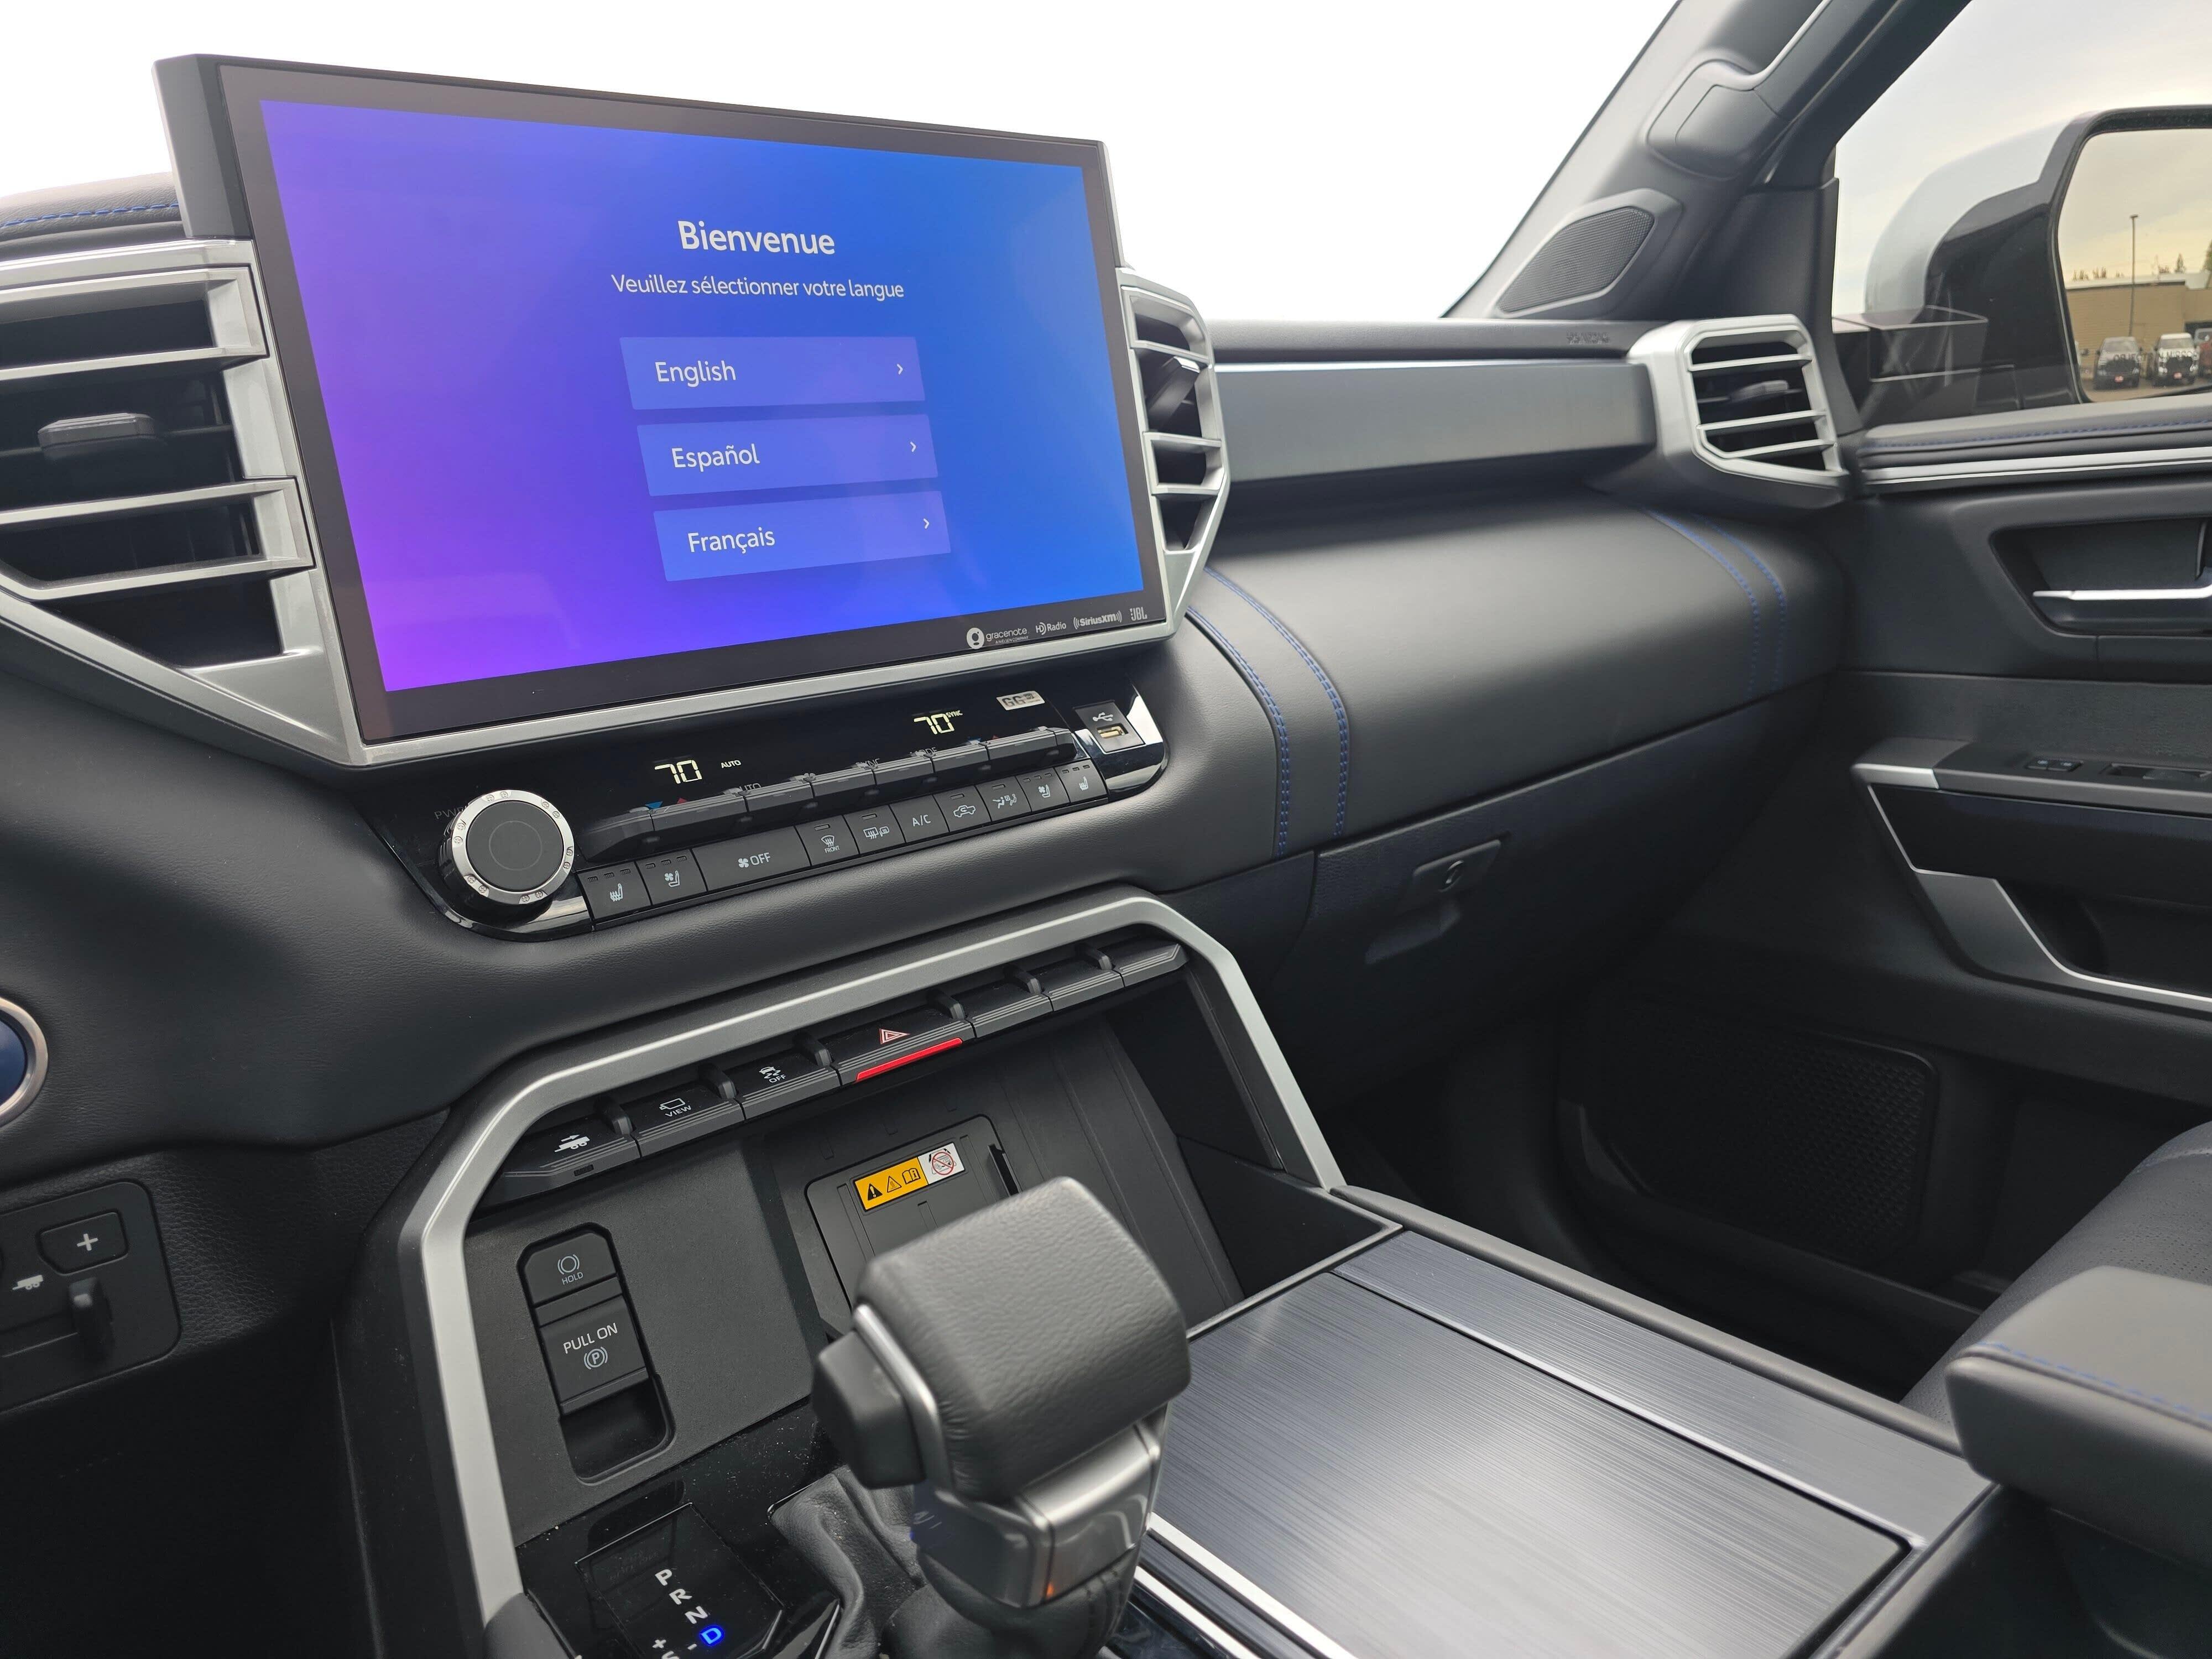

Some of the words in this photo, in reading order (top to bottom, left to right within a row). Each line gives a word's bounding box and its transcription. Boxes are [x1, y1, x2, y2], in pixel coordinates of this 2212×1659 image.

[678, 220, 836, 255] Bienvenue
[611, 274, 688, 294] Veuillez
[691, 275, 799, 296] sélectionner
[802, 280, 846, 296] votre
[848, 279, 904, 301] langue
[655, 360, 736, 387] English
[671, 444, 760, 472] Español
[687, 527, 775, 554] Français
[1130, 607, 1147, 621] JBL
[985, 628, 1027, 641] gracenote
[1047, 622, 1067, 632] Radio
[914, 713, 955, 734] 70
[946, 710, 963, 718] SYNC
[654, 760, 702, 784] 70
[721, 760, 742, 769] AUTO
[912, 814, 931, 827] A/C
[825, 845, 840, 854] FRONT
[750, 852, 771, 866] OFF
[769, 1074, 786, 1084] OFF
[665, 1105, 692, 1118] VIEW
[561, 1272, 583, 1285] HOLD
[563, 1333, 595, 1354] PULL
[597, 1322, 618, 1339] ON
[655, 1569, 672, 1586] P
[669, 1588, 693, 1605] R
[684, 1605, 708, 1624] N
[700, 1627, 722, 1645] D
